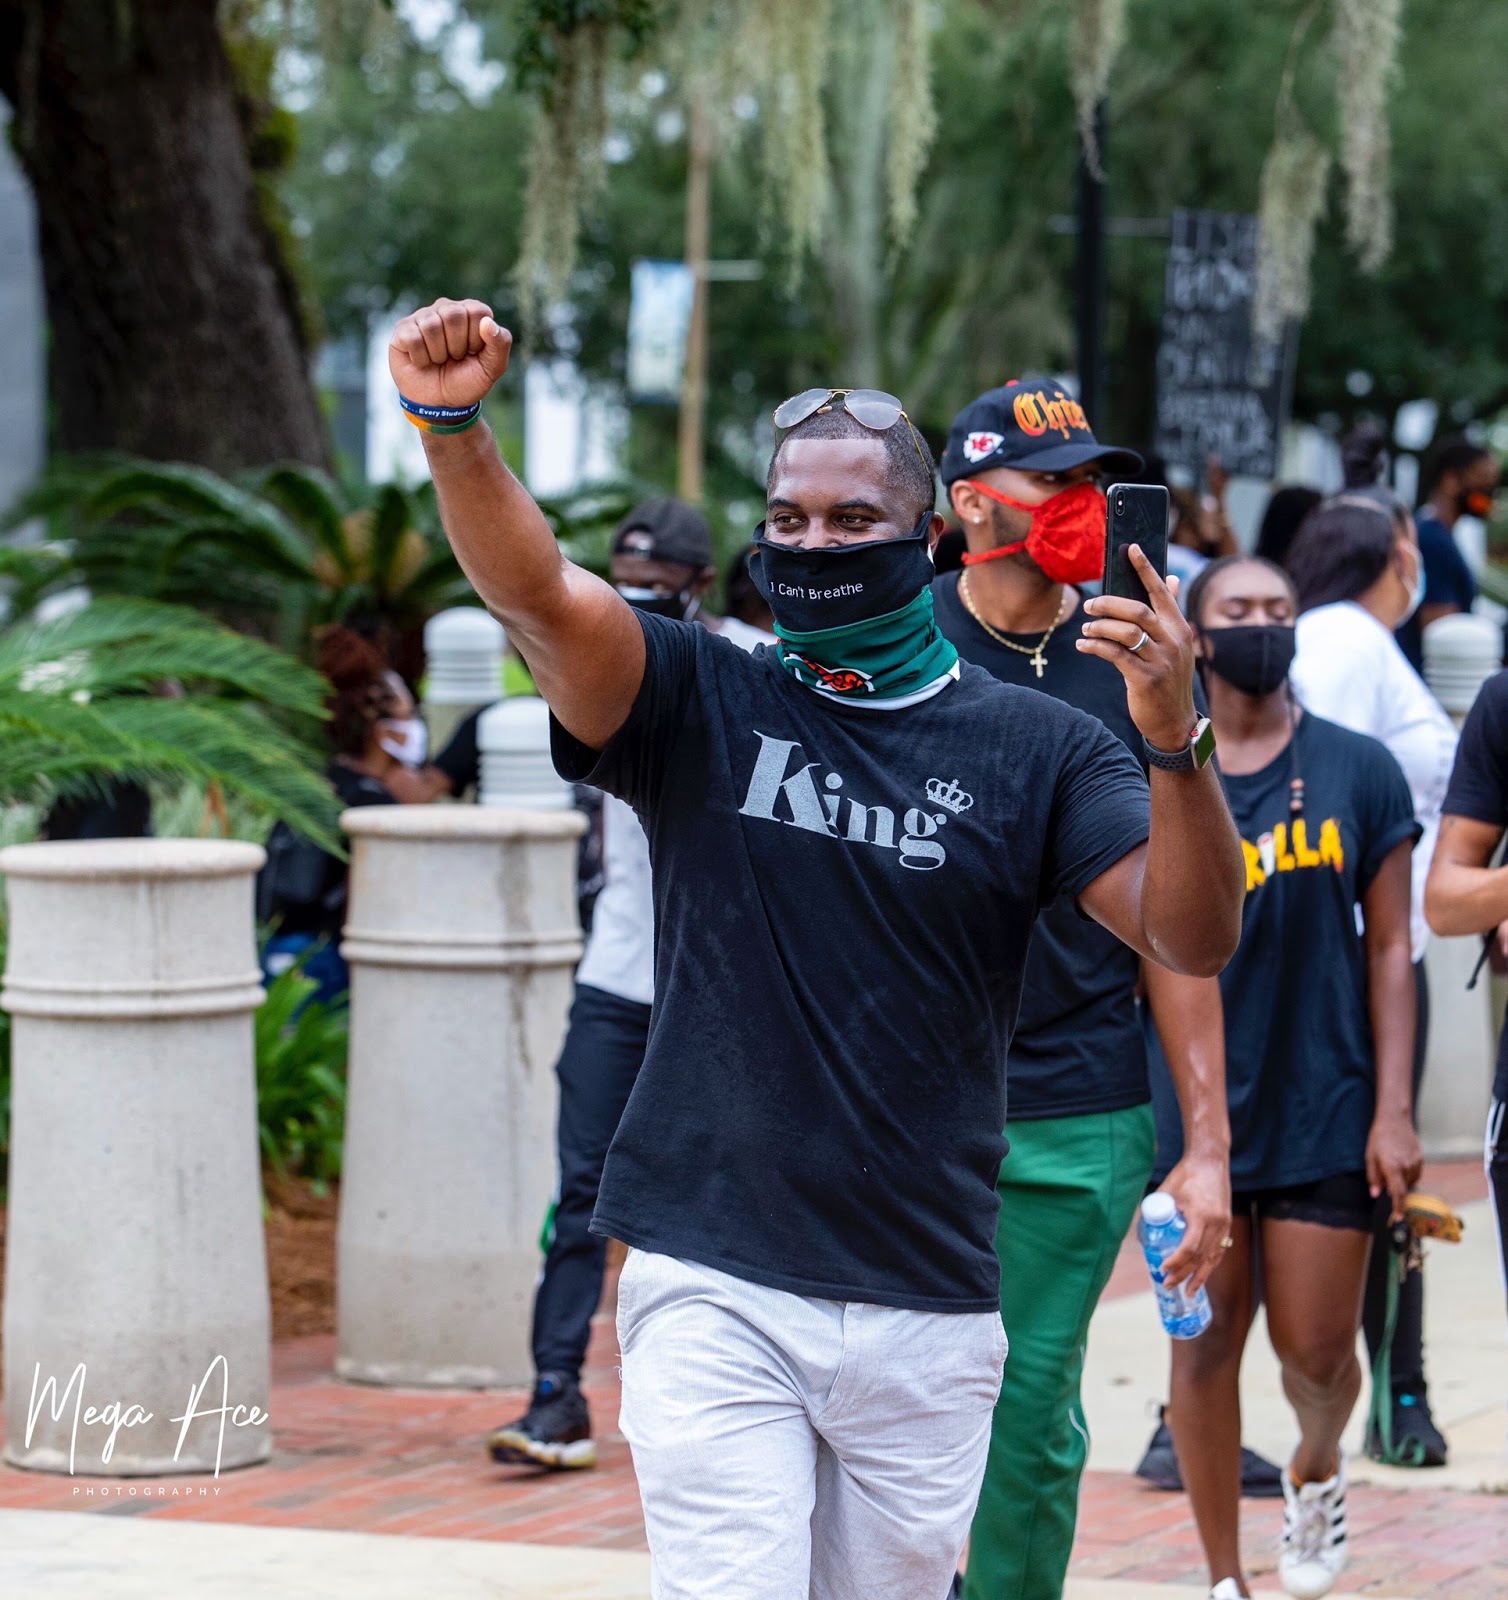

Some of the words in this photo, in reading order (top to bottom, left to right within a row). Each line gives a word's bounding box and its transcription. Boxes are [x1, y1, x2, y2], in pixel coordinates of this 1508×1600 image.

[419, 407, 441, 418] Every
[1013, 390, 1092, 440] Chie
[770, 581, 775, 593] I
[778, 583, 805, 599] Can't
[808, 582, 864, 600] Breathe
[738, 729, 947, 871] King
